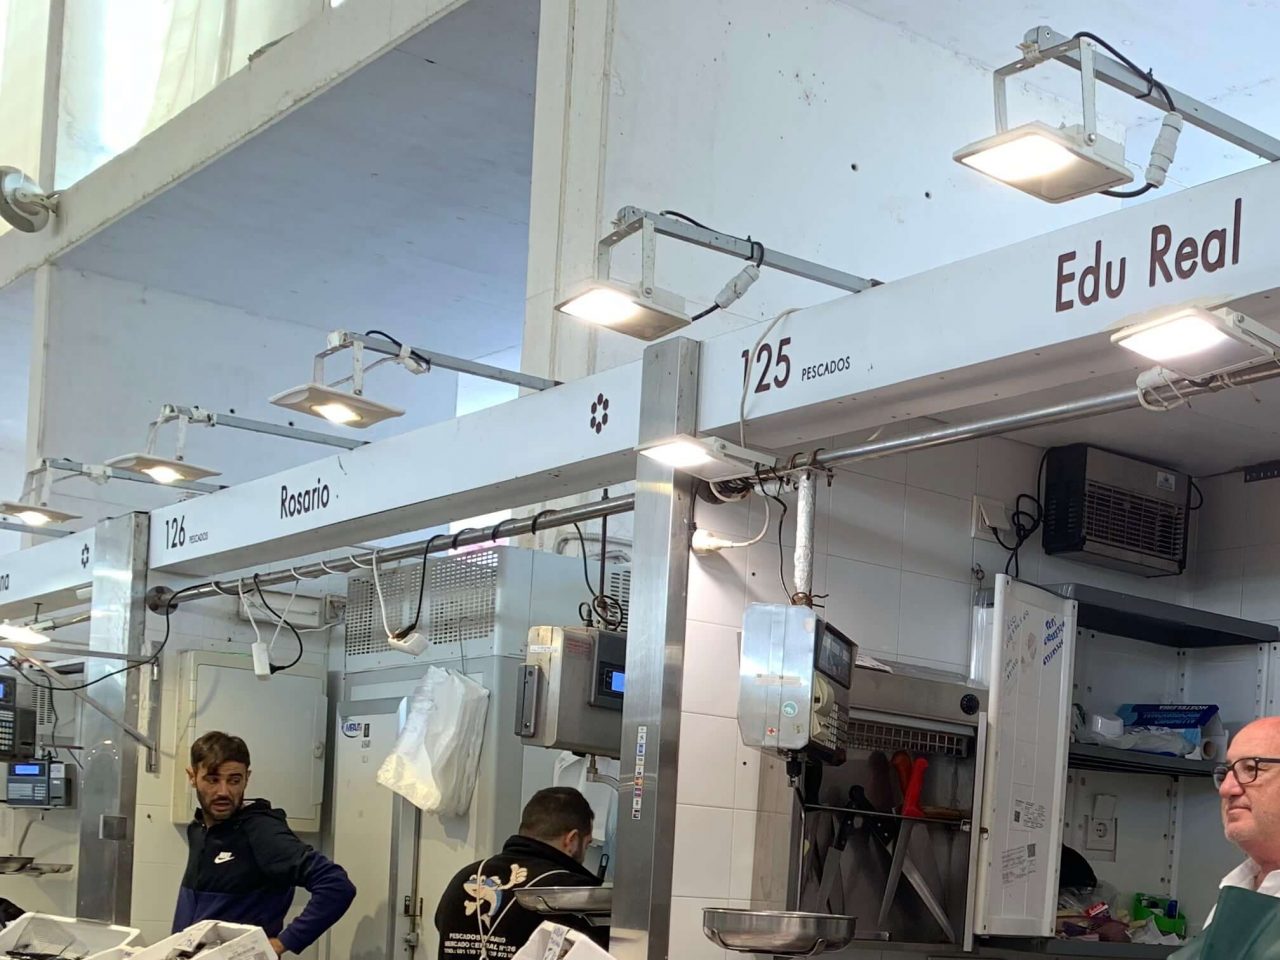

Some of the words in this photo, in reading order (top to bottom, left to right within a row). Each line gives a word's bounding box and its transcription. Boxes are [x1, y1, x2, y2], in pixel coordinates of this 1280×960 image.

[1055, 240, 1127, 314] Edu
[1149, 197, 1244, 288] Real
[741, 336, 793, 394] 125
[801, 355, 852, 382] PESCADOS
[280, 478, 331, 519] Rosario
[165, 515, 187, 550] 126
